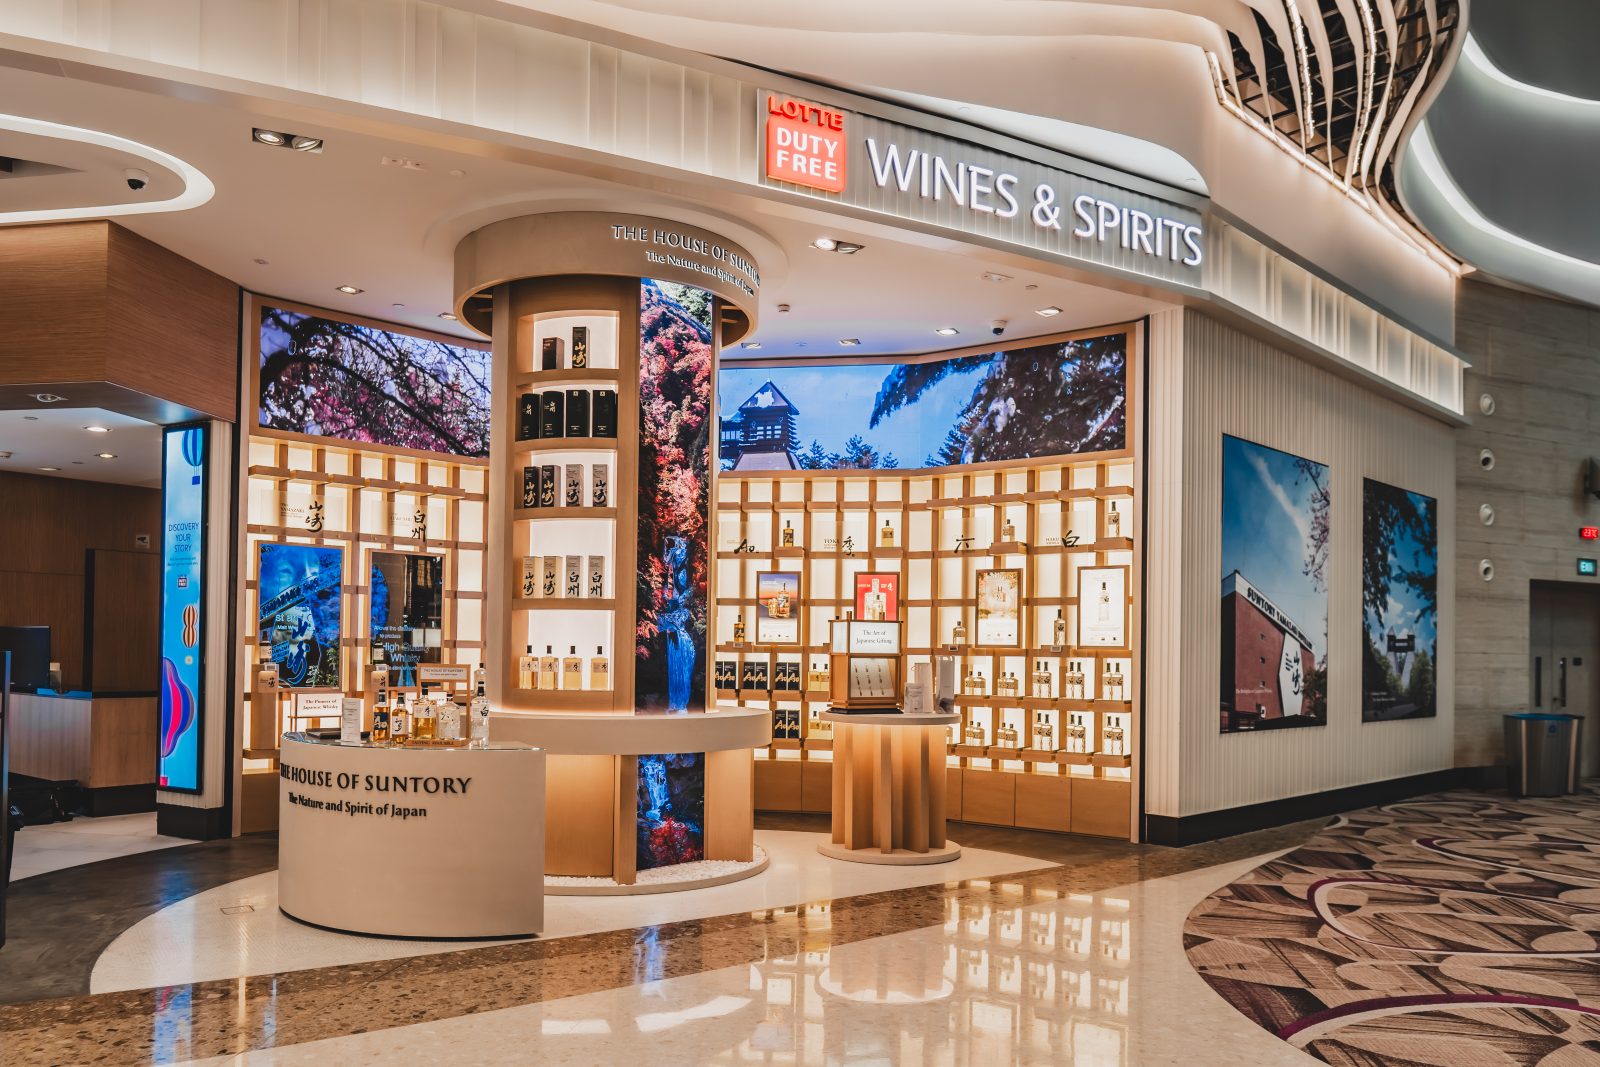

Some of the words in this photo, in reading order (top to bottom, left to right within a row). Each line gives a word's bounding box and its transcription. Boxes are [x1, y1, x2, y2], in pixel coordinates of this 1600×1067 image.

[768, 95, 843, 132] LOTTE
[777, 127, 838, 158] DUTY
[776, 149, 837, 181] FREE
[866, 138, 1019, 218] WINES
[1031, 183, 1061, 230] &
[1073, 195, 1202, 266] SPIRITS
[611, 225, 648, 242] THE
[653, 229, 708, 256] HOUSE
[712, 245, 728, 262] OF
[645, 250, 665, 264] The
[667, 254, 701, 271] Nature
[701, 265, 718, 277] and
[718, 269, 736, 284] Spirit
[168, 522, 200, 532] DISCOVERY
[175, 533, 192, 542] YOUR
[412, 509, 426, 542] 白州
[174, 544, 192, 552] STORY
[954, 534, 975, 553] 六
[567, 571, 580, 597] 白州
[590, 571, 603, 597] 白州
[1247, 587, 1275, 617] SUNTORY
[1276, 612, 1298, 636] YAMAZAKI
[383, 642, 400, 653] High
[390, 653, 421, 662] Whisky
[280, 762, 290, 779] THE
[291, 766, 333, 788] HOUSE
[337, 772, 359, 789] OF
[365, 775, 472, 794] SUNTORY
[298, 794, 324, 809] Nature
[325, 800, 343, 812] and
[345, 801, 374, 816] Spirit
[376, 803, 389, 815] of
[391, 804, 427, 820] Japan
